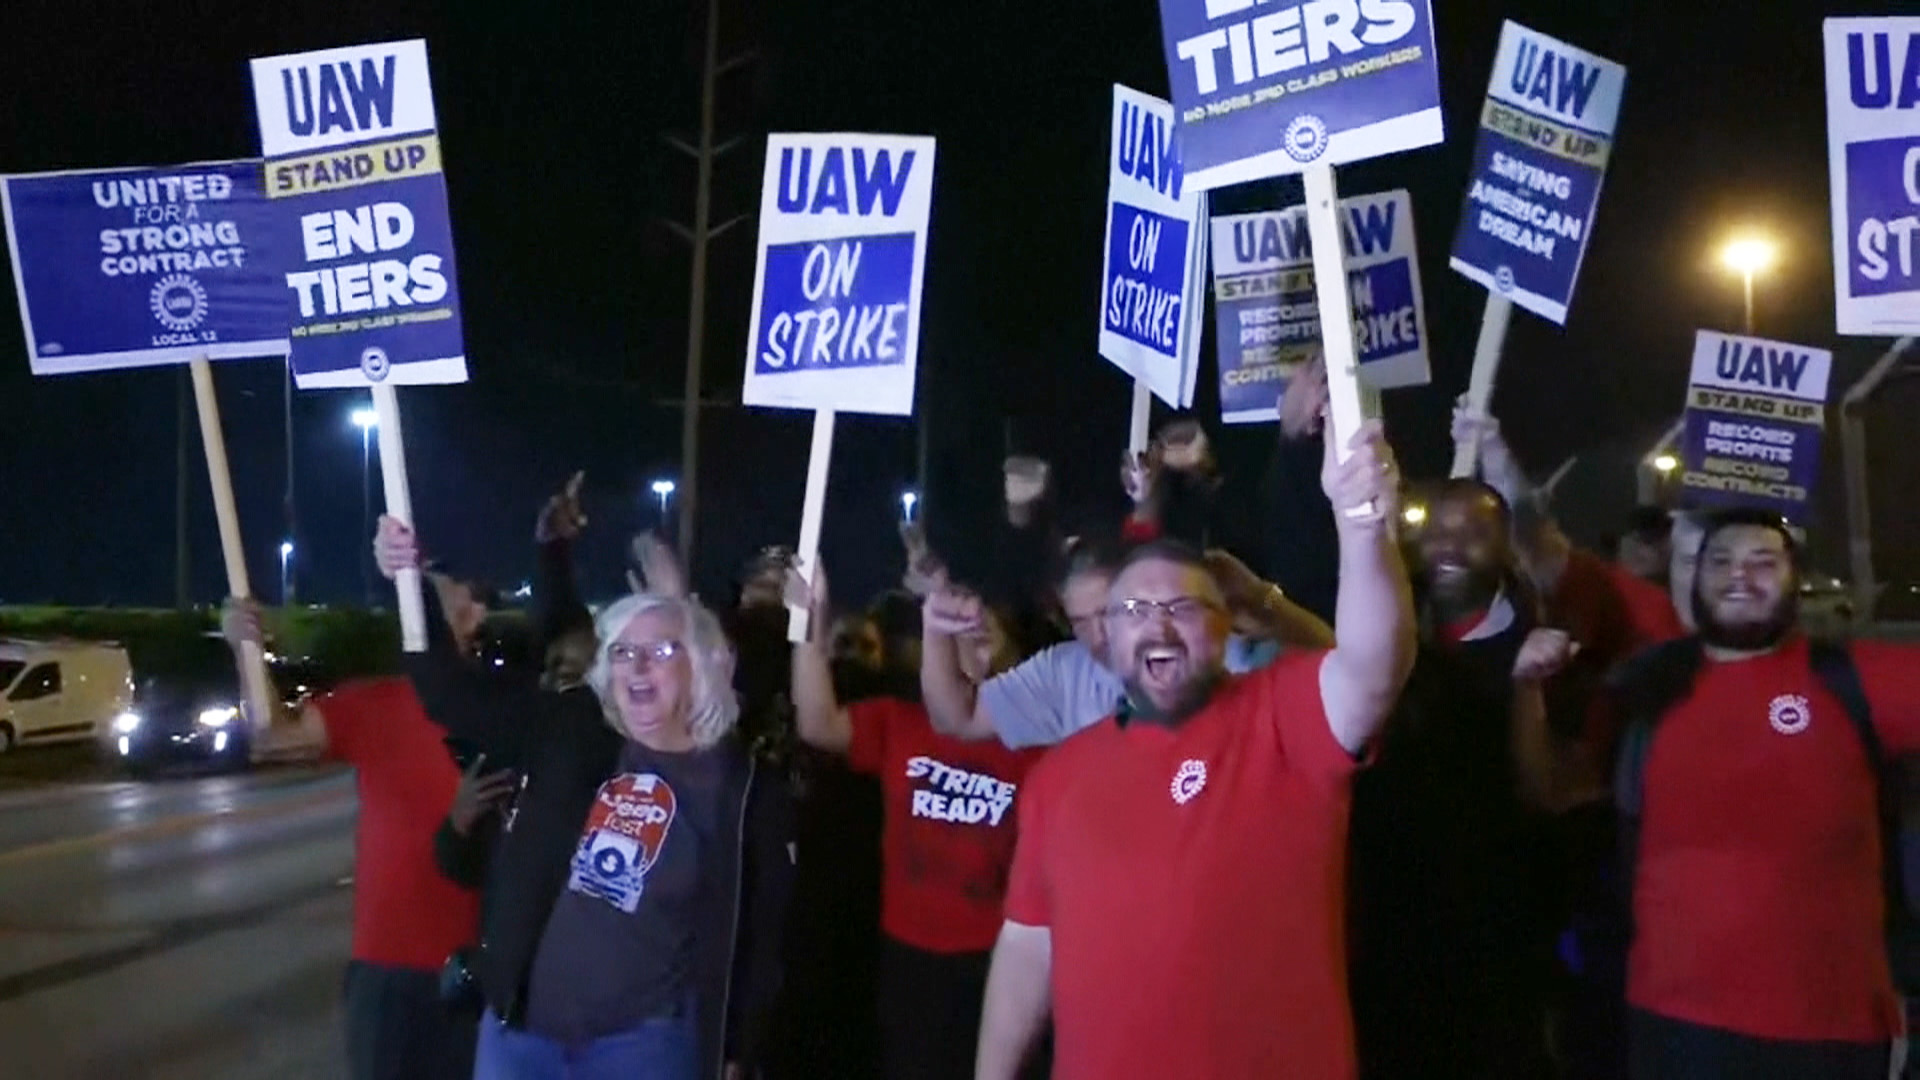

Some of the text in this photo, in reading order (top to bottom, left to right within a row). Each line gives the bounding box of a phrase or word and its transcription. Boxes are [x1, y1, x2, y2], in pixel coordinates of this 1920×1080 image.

[1176, 0, 1416, 95] TIERS
[281, 55, 396, 137] UAW
[1511, 36, 1602, 120] UAW
[277, 144, 426, 190] STAND UP
[1119, 100, 1184, 201] UAW
[1489, 151, 1571, 200] SAVING
[93, 174, 232, 208] UNITED
[777, 147, 916, 217] UAW
[1469, 179, 1582, 241] AMERICAN
[100, 221, 240, 253] STRONG
[135, 203, 199, 224] FOR A
[301, 202, 415, 262] END
[1479, 208, 1555, 260] DREAM
[101, 247, 245, 277] CONTRACT
[802, 241, 862, 301] ON
[1129, 214, 1161, 274] ON
[286, 254, 448, 317] TIERS
[1109, 275, 1181, 347] STRIKE
[152, 331, 217, 346] LOCAL 12
[763, 302, 907, 367] STRIKE
[1716, 340, 1810, 392] UAW
[1696, 391, 1816, 419] STAND UP
[906, 756, 1016, 798] STRIKE
[911, 789, 1012, 826] READY
